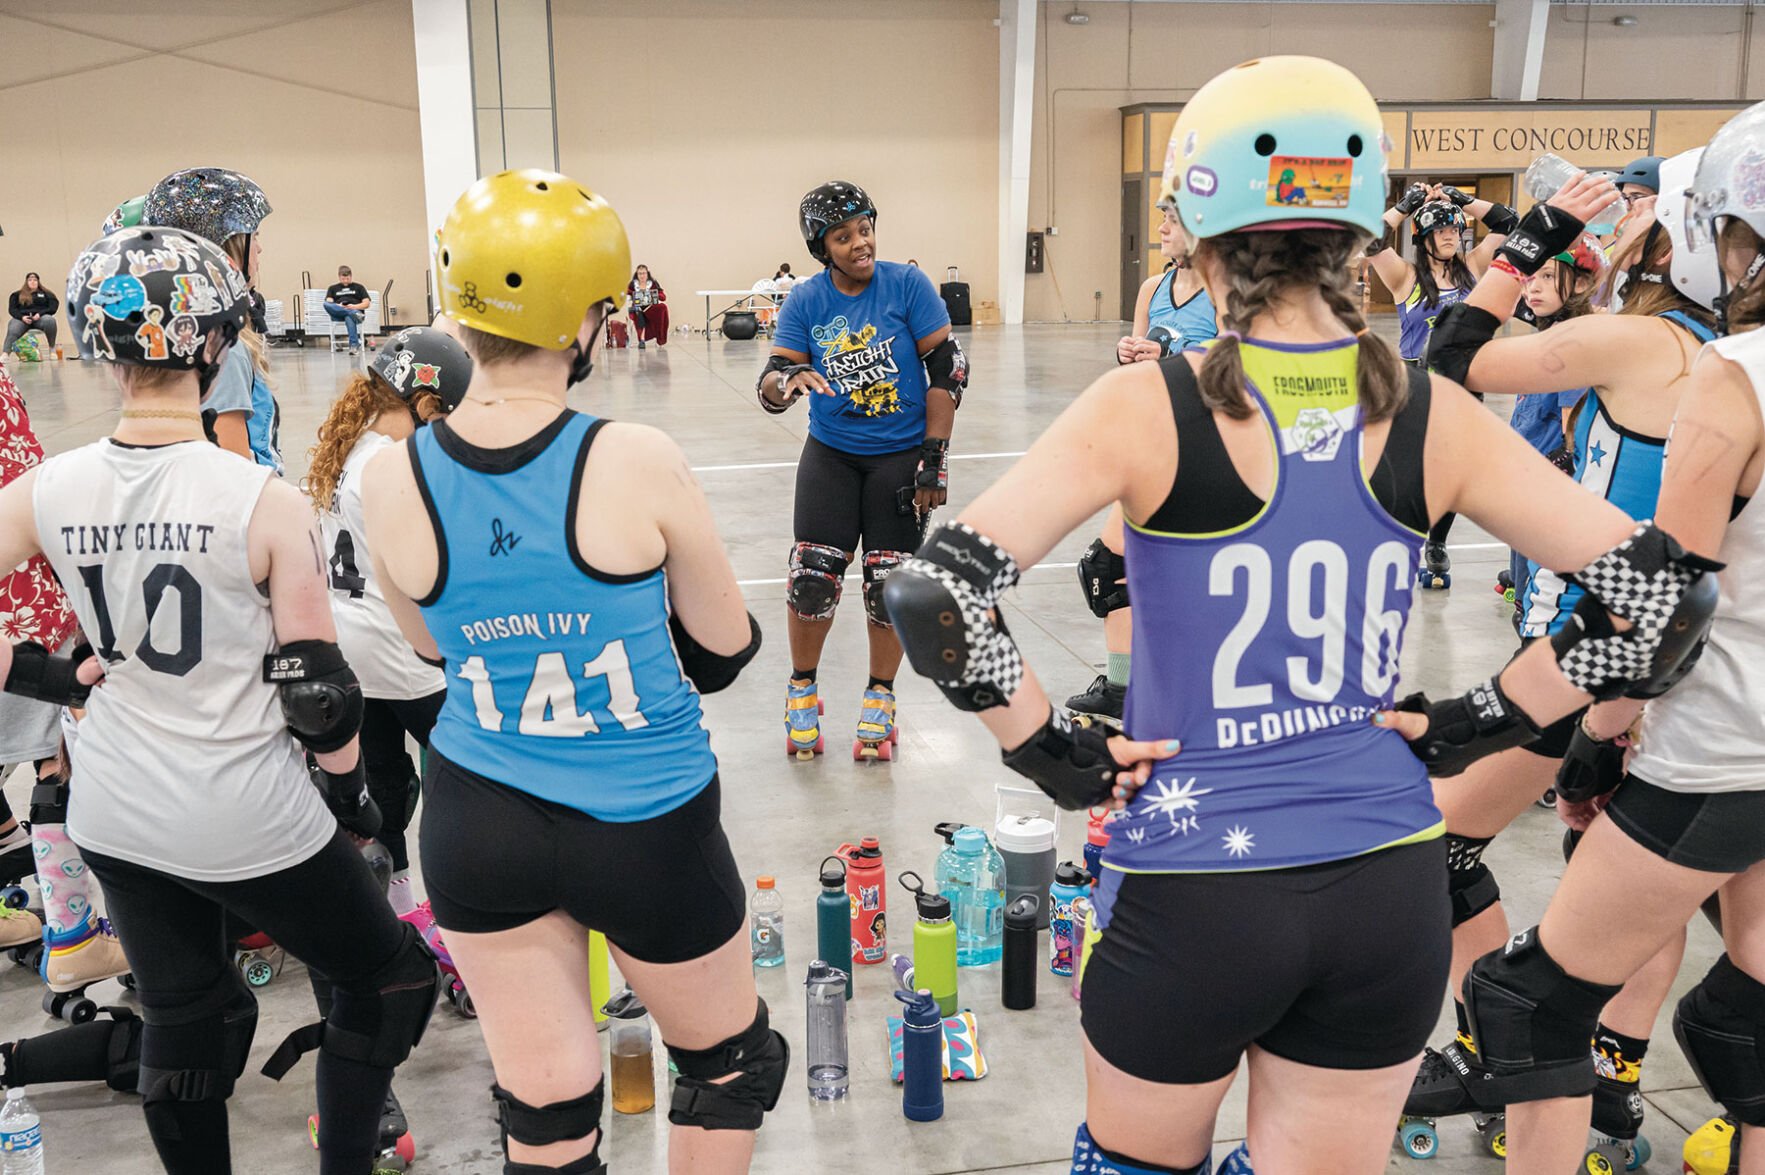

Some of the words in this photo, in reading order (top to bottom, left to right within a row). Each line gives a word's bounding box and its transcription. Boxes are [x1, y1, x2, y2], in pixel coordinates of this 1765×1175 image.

[1412, 128, 1484, 152] WEST
[1493, 127, 1650, 151] CONCOURSE
[1510, 234, 1540, 252] 187
[821, 335, 896, 376] FREIGHT
[826, 356, 900, 395] TRAIN
[1273, 376, 1349, 397] FROGMOUTH
[61, 523, 127, 555] TINY
[135, 522, 215, 553] GIANT
[327, 529, 366, 599] 4
[77, 563, 202, 678] 10
[460, 612, 549, 646] POISON
[547, 612, 592, 636] IVY
[1208, 539, 1411, 709] 296
[272, 658, 303, 671] 187
[455, 637, 651, 738] 141
[757, 928, 770, 944] G
